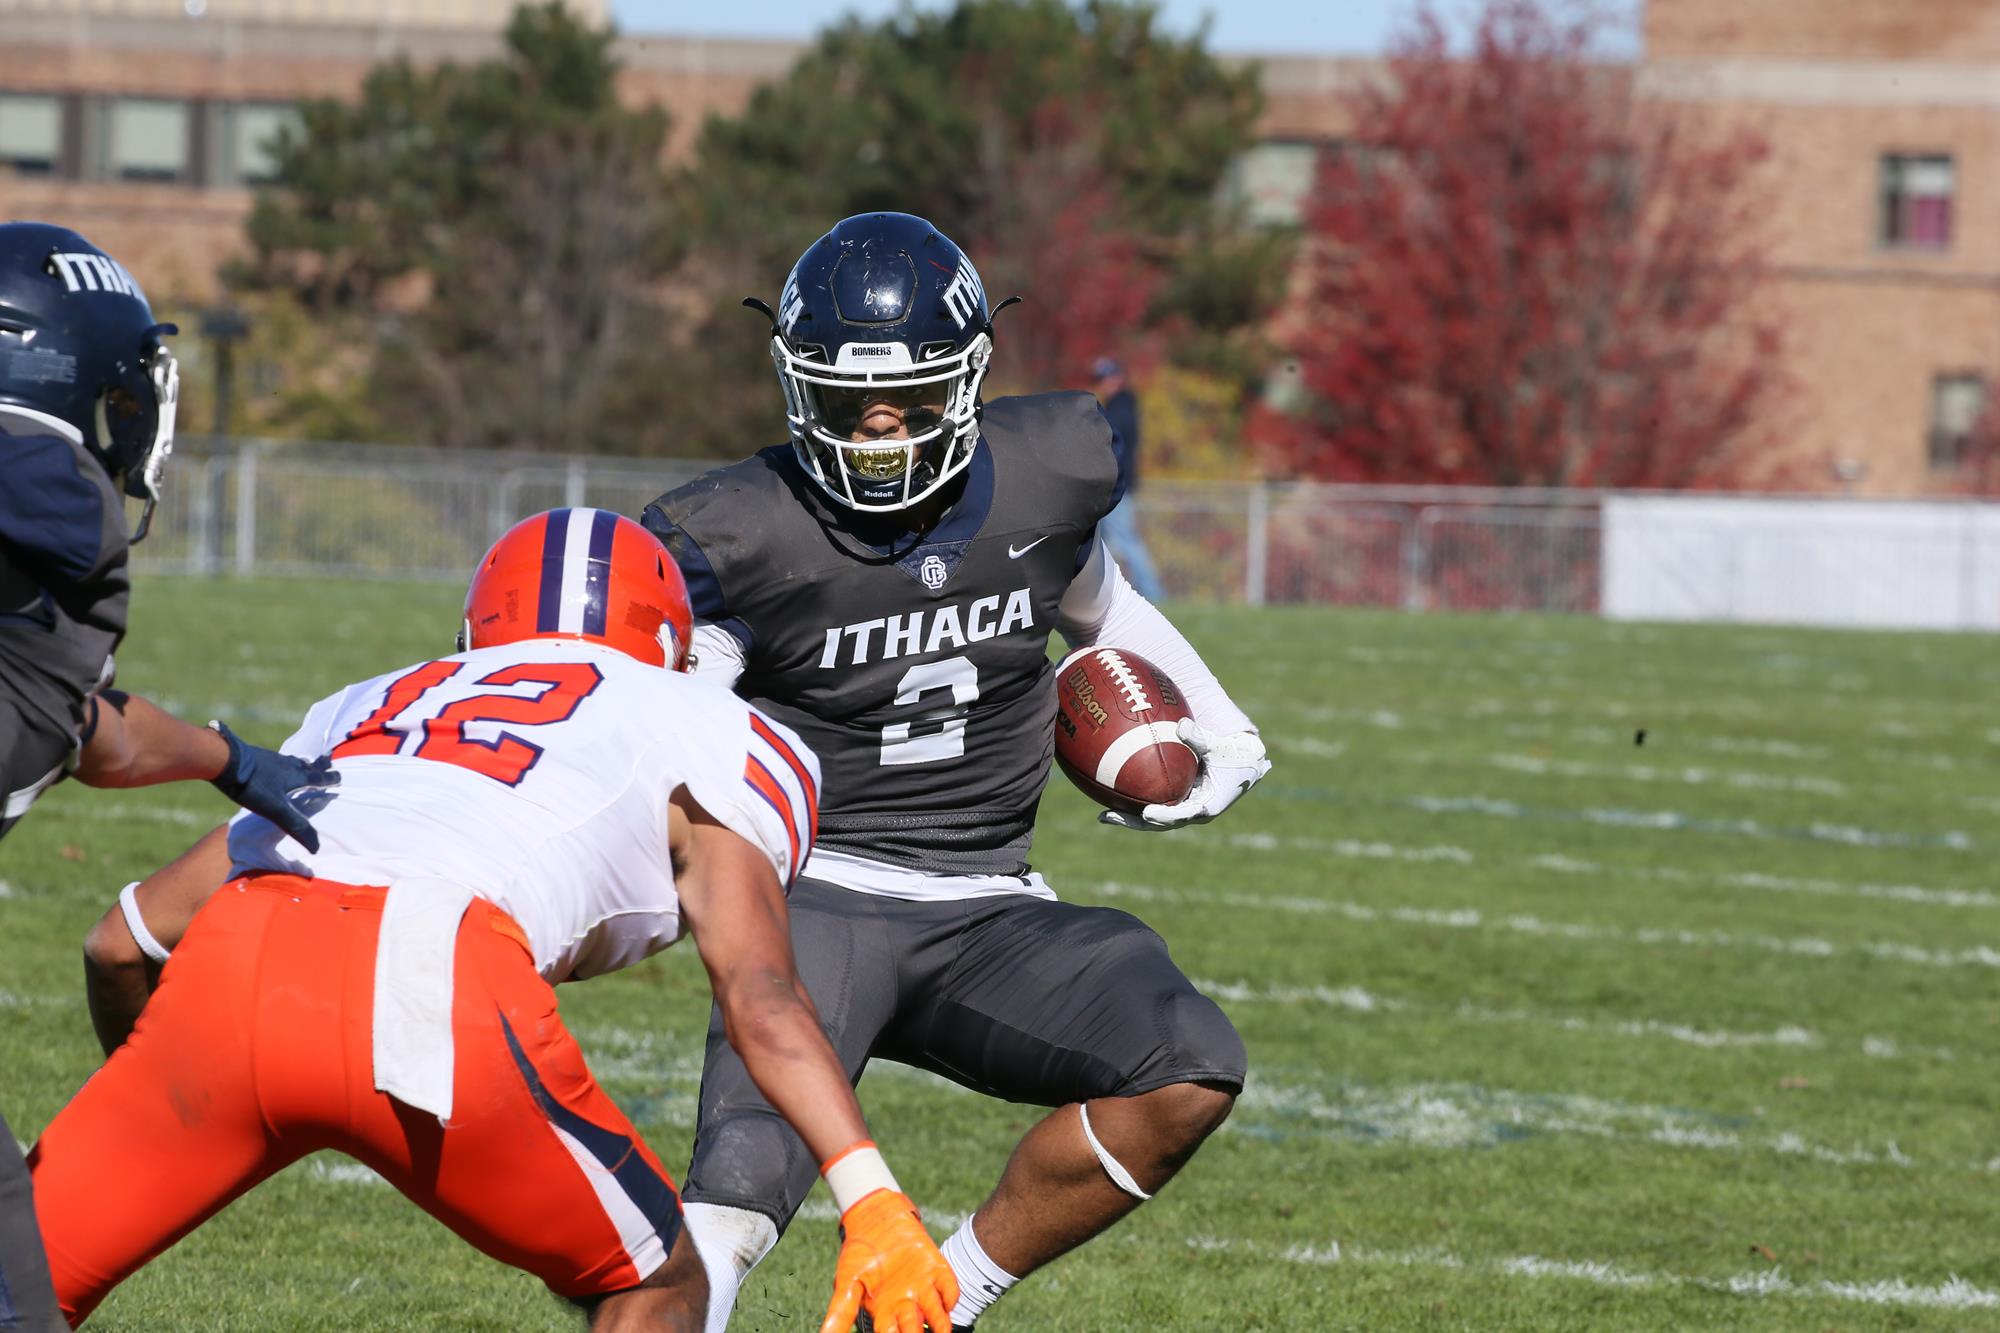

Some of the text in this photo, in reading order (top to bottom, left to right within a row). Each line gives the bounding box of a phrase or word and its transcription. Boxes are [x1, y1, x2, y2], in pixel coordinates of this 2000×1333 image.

[50, 253, 147, 303] ITHA
[851, 346, 892, 357] BOMBERS
[818, 588, 1034, 669] ITHACA
[330, 660, 605, 788] 12
[1067, 666, 1109, 727] Wilson
